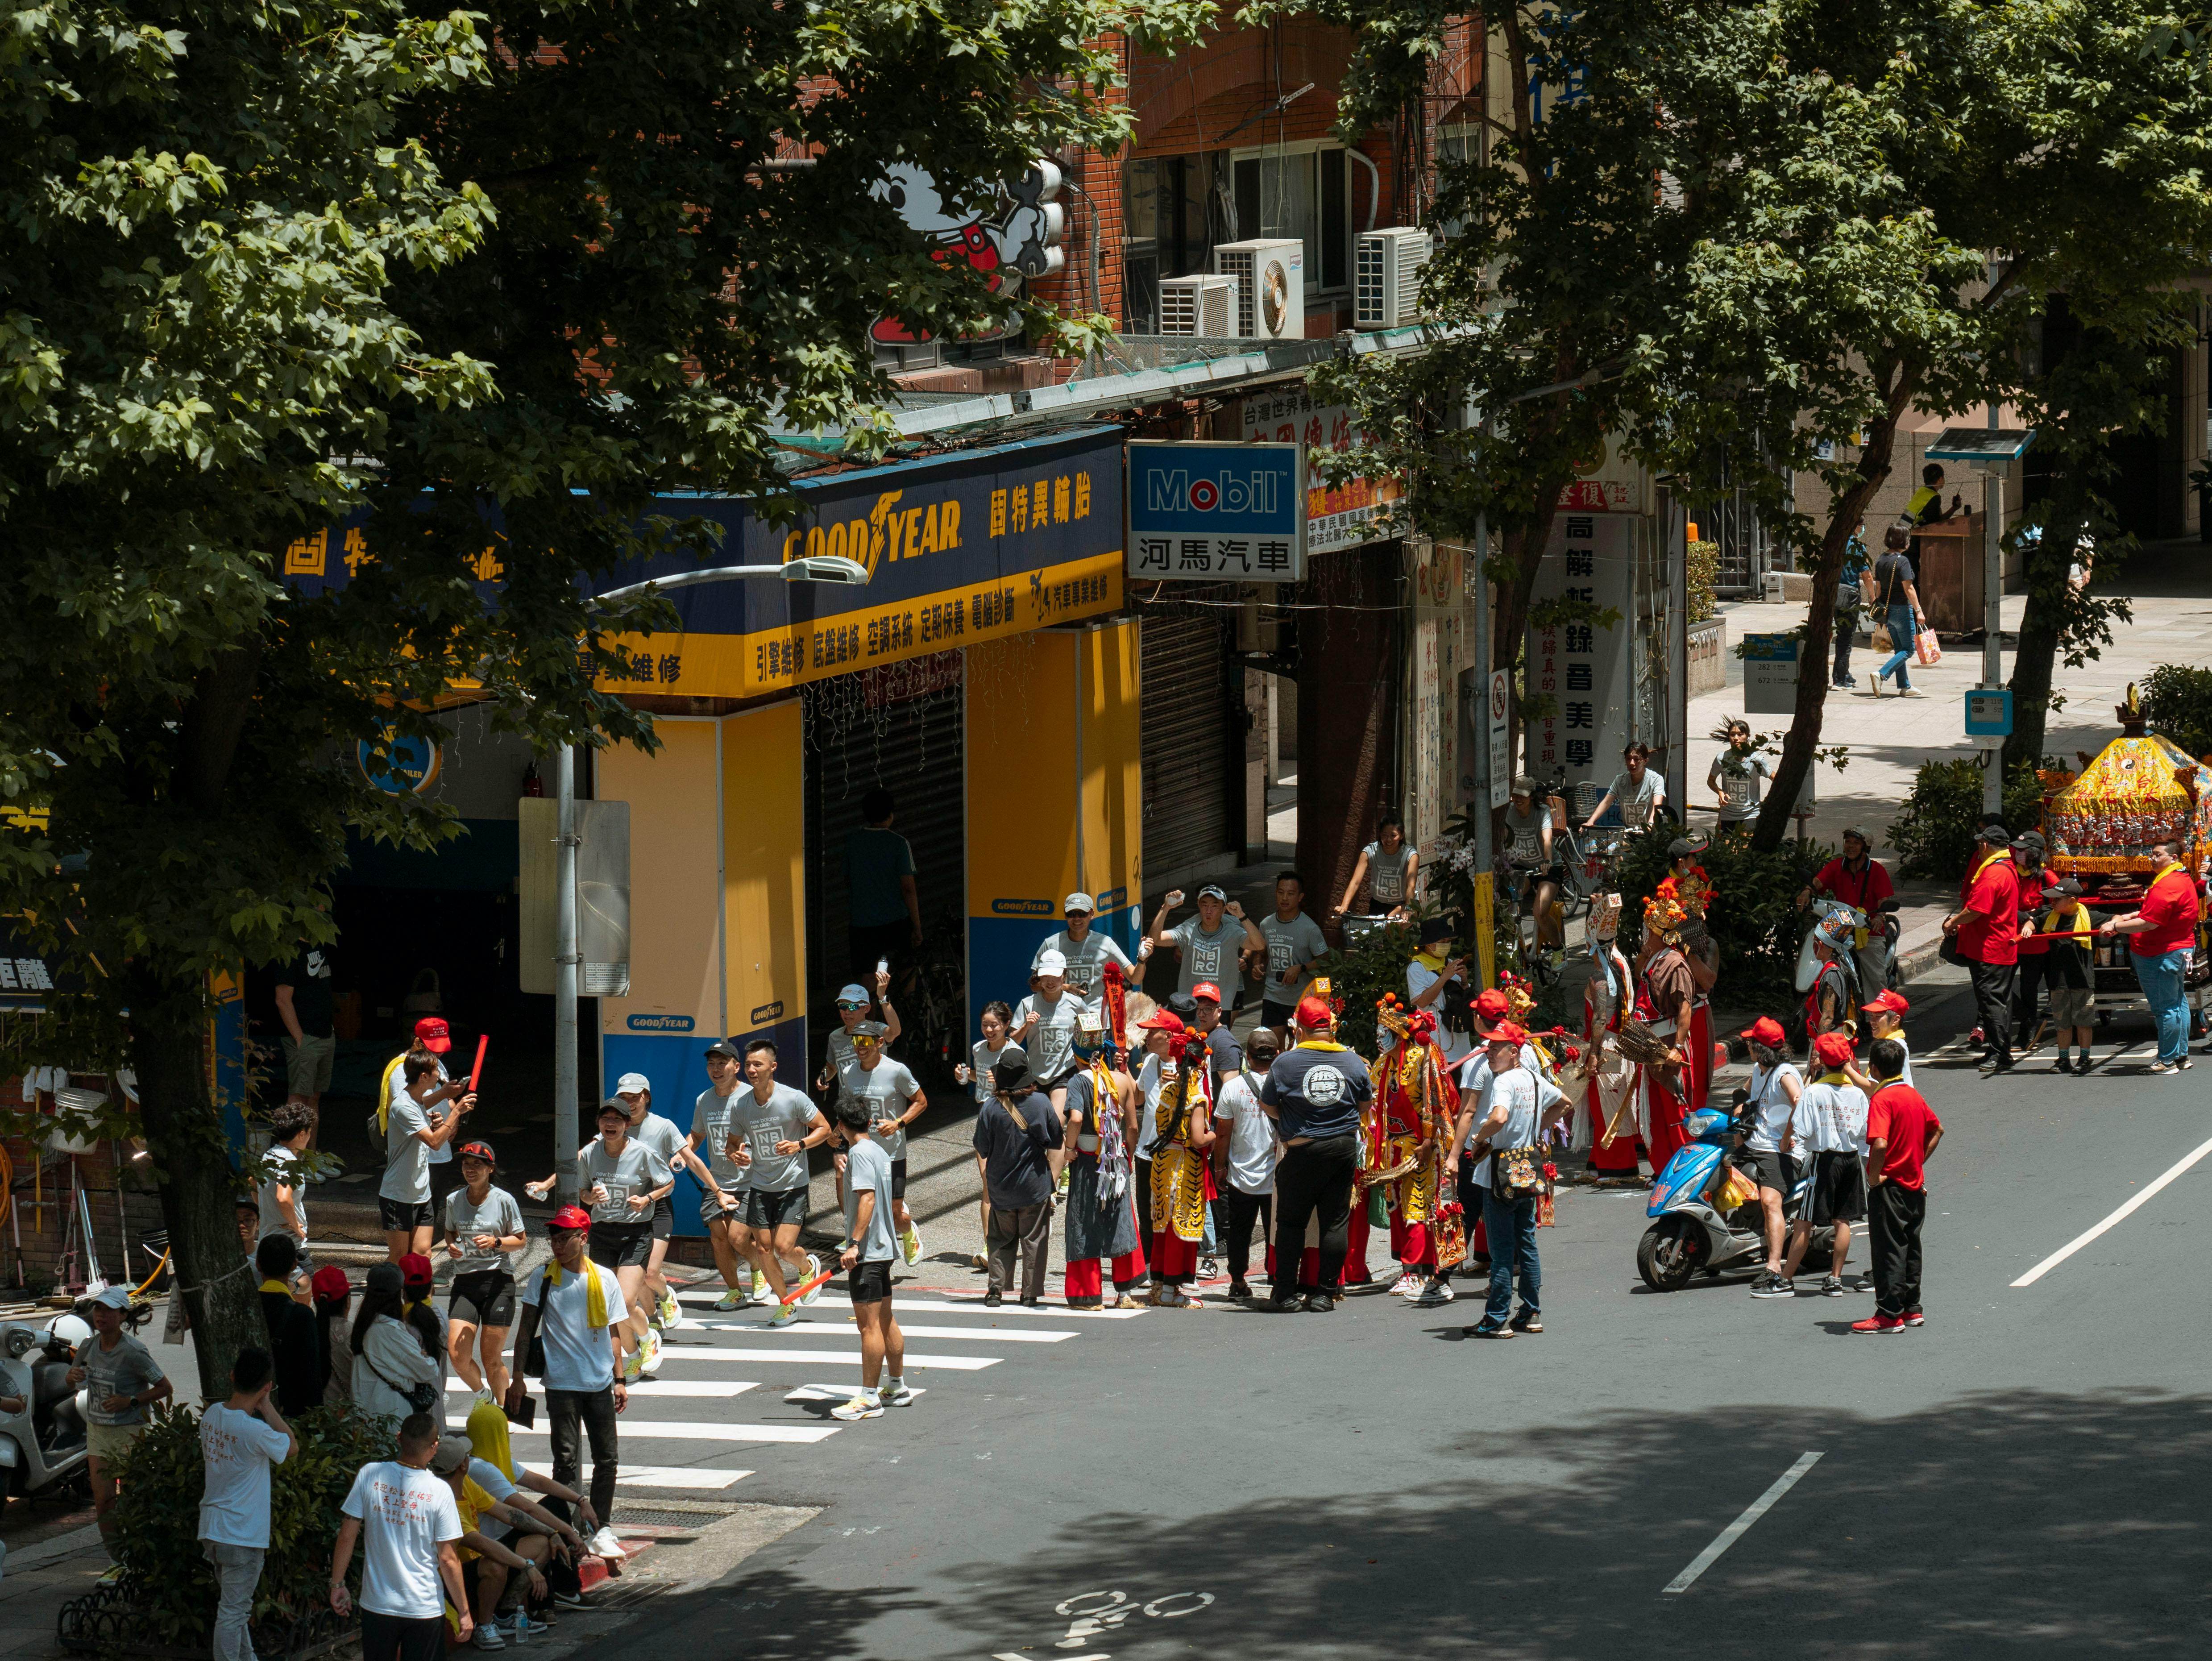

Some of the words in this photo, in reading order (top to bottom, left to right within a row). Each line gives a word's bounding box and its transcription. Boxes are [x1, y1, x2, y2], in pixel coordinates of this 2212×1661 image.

[1148, 469, 1277, 513] Mobil
[990, 471, 1090, 538] 固特異輪胎
[783, 500, 960, 581] GOODYEAR
[1140, 538, 1290, 573] 河馬汽車
[756, 635, 804, 682] 引擎維修
[813, 623, 859, 669] 底盤維修
[867, 612, 913, 657] 空調系統
[921, 598, 965, 643] 定期保養
[972, 586, 1014, 627] 電腦診斷
[1053, 574, 1108, 612] 汽車專業維修
[1730, 784, 1747, 793] NB
[1731, 793, 1746, 802] RC
[1628, 807, 1645, 815] NB
[1629, 815, 1645, 826] RC
[1518, 838, 1535, 847] NB
[1520, 848, 1536, 857] RC
[1381, 879, 1398, 888] NB
[1381, 887, 1399, 897] RC
[1100, 892, 1125, 907] GOODYEAR
[997, 903, 1049, 911] GOODYEAR
[1196, 951, 1216, 961] NB
[1272, 948, 1288, 958] NB
[307, 951, 321, 966] NIKE
[1273, 958, 1289, 969] RC
[1195, 961, 1215, 972] RC
[1069, 969, 1090, 979] NB
[754, 1005, 781, 1020] GOODYEAR
[633, 1018, 689, 1028] GOODYEAR
[1044, 1030, 1065, 1040] NB
[1045, 1041, 1064, 1051] RC
[759, 1131, 780, 1143] NB
[770, 1158, 790, 1166] TAIWAN
[374, 1481, 433, 1503] 恭迎松山慈祐宮
[383, 1495, 418, 1511] 天上聖母
